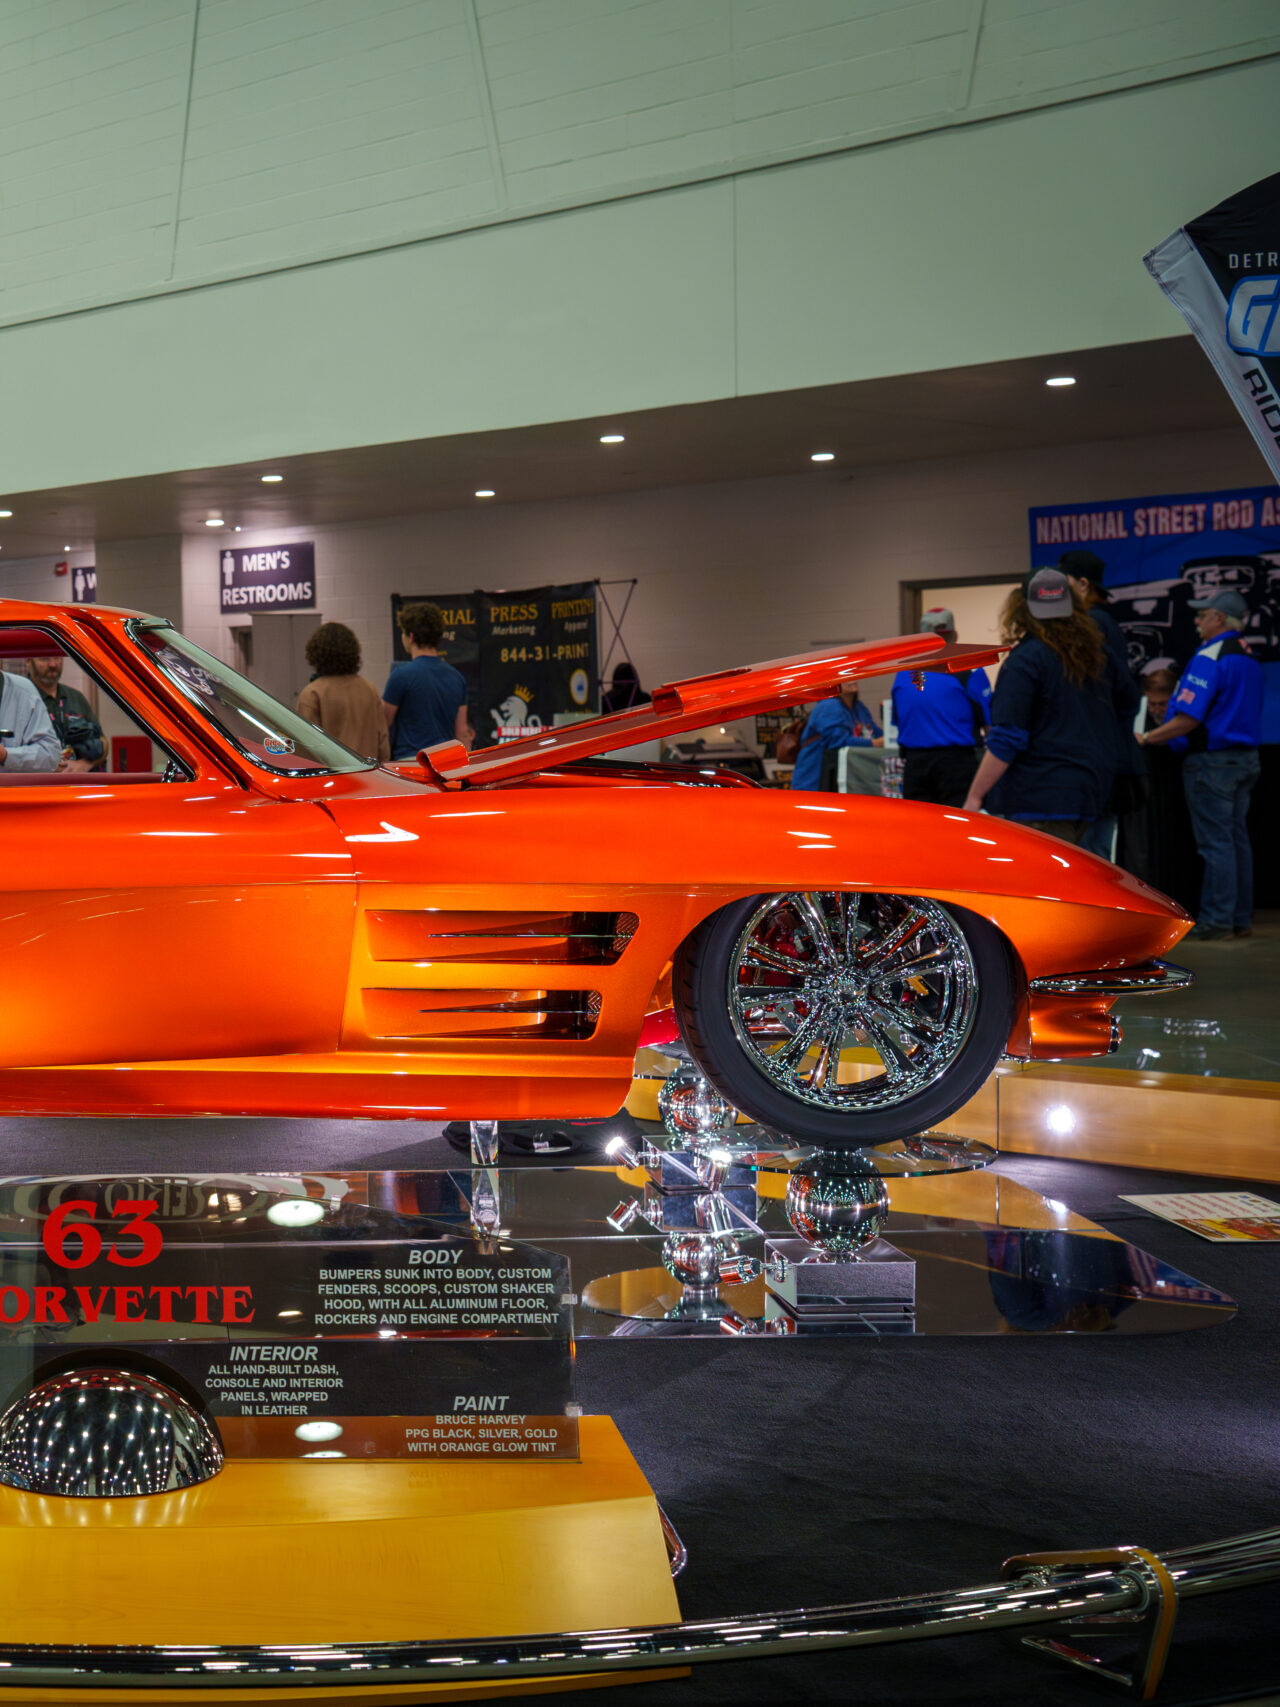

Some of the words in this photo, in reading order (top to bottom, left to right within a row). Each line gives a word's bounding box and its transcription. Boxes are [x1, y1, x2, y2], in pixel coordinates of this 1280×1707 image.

[1036, 510, 1128, 544] NATIONAL
[1134, 504, 1207, 537] STREET
[1212, 500, 1255, 531] ROD
[242, 551, 290, 573] MEN'S
[222, 582, 313, 606] RESTROOMS
[490, 603, 538, 623] PRESS
[42, 1199, 163, 1269] 63
[408, 1249, 464, 1265] BODY
[320, 1269, 381, 1279] BUMPERS
[384, 1269, 420, 1279] SUNK
[423, 1269, 453, 1279] INTO
[456, 1269, 495, 1281] BODY,
[497, 1269, 552, 1279] CUSTOM
[318, 1284, 381, 1296] FENDERS,
[384, 1284, 441, 1296] SCOOPS,
[444, 1284, 498, 1294] CUSTOM
[501, 1284, 555, 1294] SHAKER
[324, 1298, 365, 1311] HOOD,
[368, 1298, 400, 1309] WITH
[403, 1298, 427, 1309] ALL
[429, 1298, 498, 1309] ALUMINUM
[501, 1298, 548, 1310] FLOOR,
[315, 1314, 377, 1324] ROCKERS
[380, 1314, 407, 1324] AND
[410, 1314, 458, 1324] ENGINE
[461, 1314, 559, 1324] COMPARTMENT
[230, 1346, 318, 1361] INTERIOR
[208, 1365, 230, 1374] ALL
[233, 1365, 301, 1374] HAND-BUILT
[304, 1365, 339, 1376] DASH,
[205, 1379, 260, 1388] CONSOLE
[262, 1379, 287, 1388] AND
[289, 1379, 344, 1388] INTERIOR
[221, 1392, 269, 1403] PANELS,
[271, 1392, 328, 1401] WRAPPED
[453, 1396, 510, 1411] PAINT
[241, 1405, 253, 1415] IN
[256, 1405, 308, 1415] LEATHER
[435, 1415, 476, 1424] BRUCE
[479, 1415, 527, 1424] HARVEY
[405, 1429, 430, 1438] PPG
[432, 1429, 475, 1440] BLACK,
[478, 1429, 522, 1440] SILVER,
[524, 1429, 558, 1438] GOLD
[407, 1442, 437, 1452] WITH
[439, 1442, 490, 1452] ORANGE
[492, 1442, 528, 1452] GLOW
[530, 1442, 557, 1452] TINT
